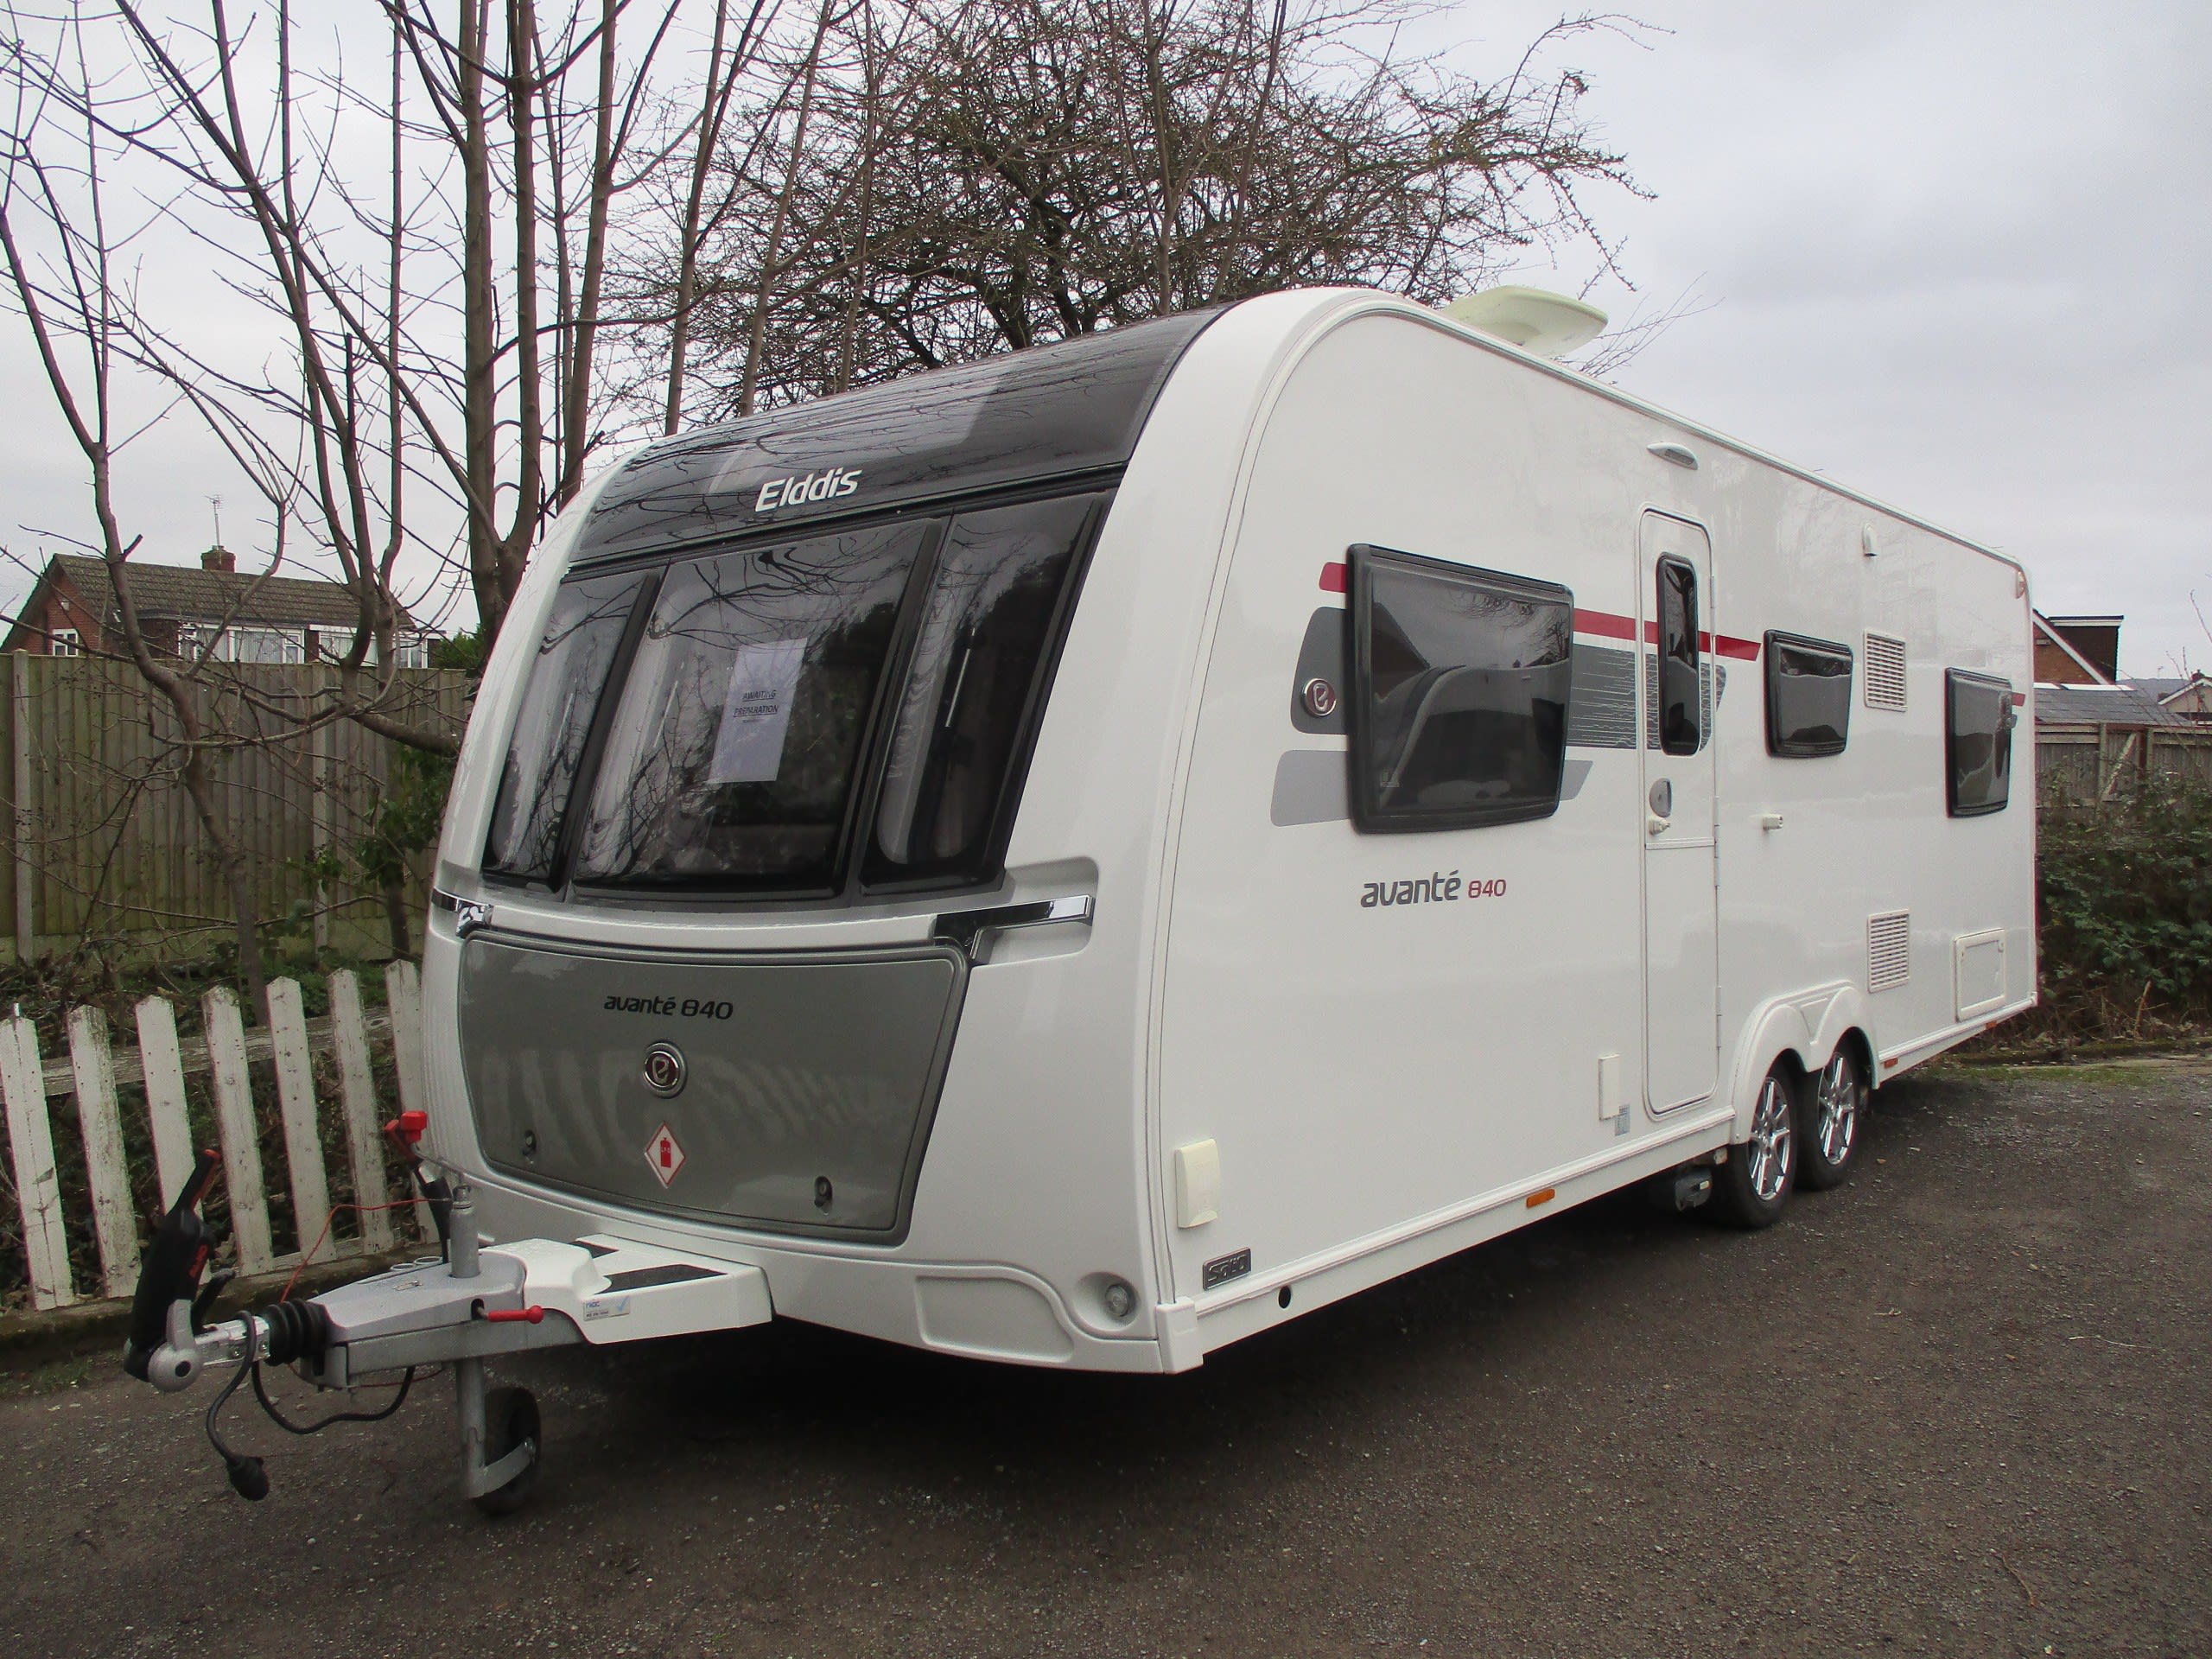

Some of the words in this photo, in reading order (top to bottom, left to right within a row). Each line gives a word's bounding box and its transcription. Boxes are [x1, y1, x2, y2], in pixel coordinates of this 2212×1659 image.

[755, 467, 862, 512] Elddis
[742, 690, 777, 702] AWAITING
[733, 705, 779, 717] PREPARATION
[1360, 869, 1461, 908] avanté
[1468, 879, 1506, 899] 840
[604, 995, 677, 1016] avanté
[681, 999, 734, 1020] 840
